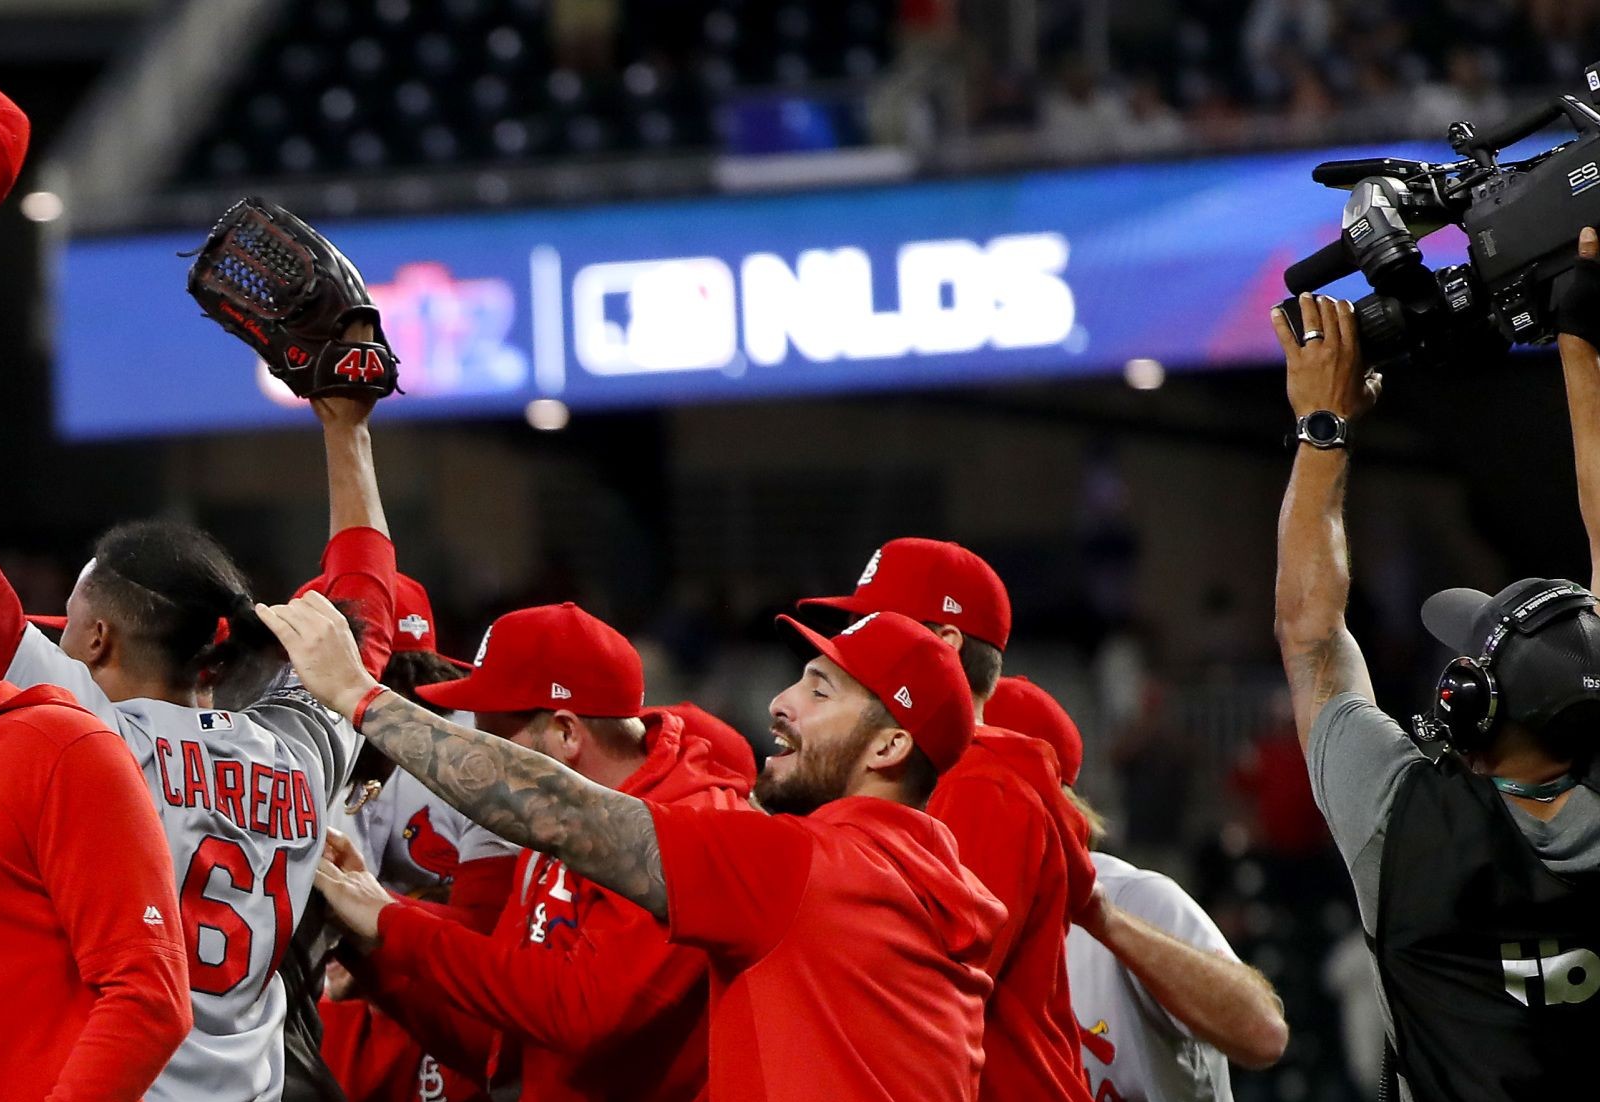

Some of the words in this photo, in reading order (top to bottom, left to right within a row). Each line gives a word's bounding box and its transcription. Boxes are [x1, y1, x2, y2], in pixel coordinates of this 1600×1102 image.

[334, 348, 385, 382] 44
[741, 231, 1076, 366] NLDS
[179, 834, 294, 1002] 61
